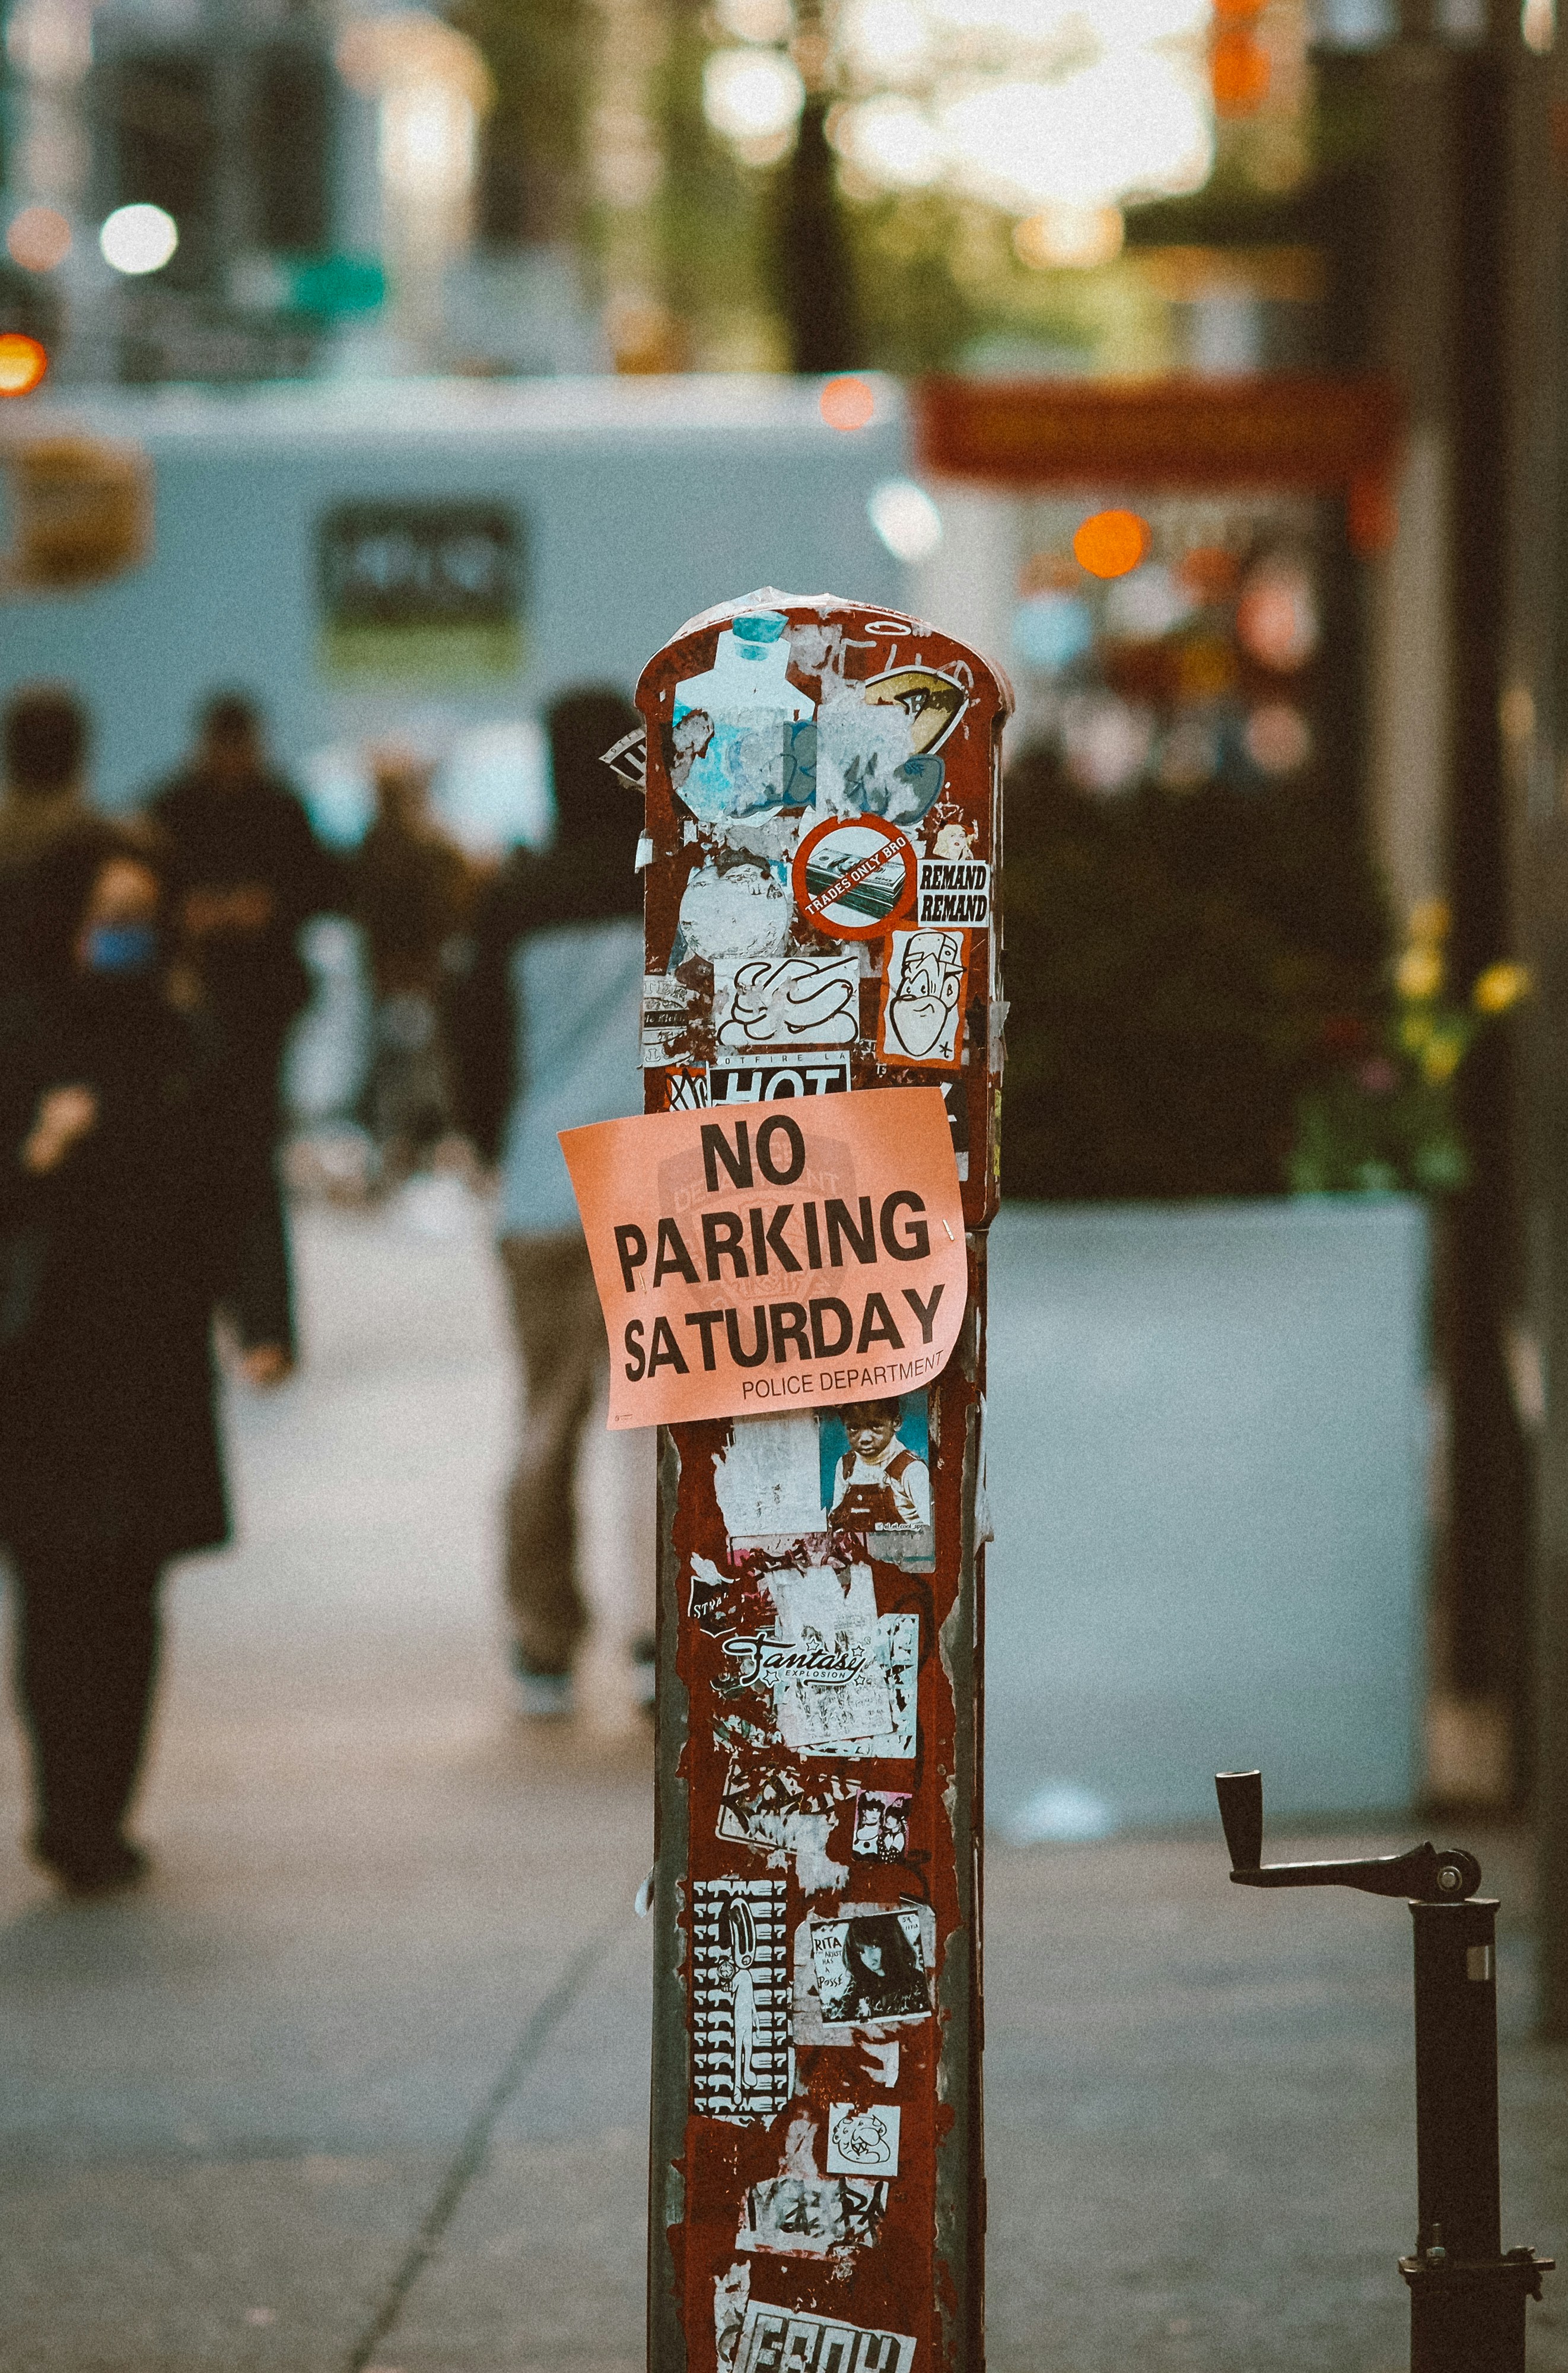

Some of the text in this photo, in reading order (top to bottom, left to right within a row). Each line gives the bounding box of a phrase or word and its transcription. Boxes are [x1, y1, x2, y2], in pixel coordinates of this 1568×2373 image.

[805, 836, 906, 915] TRADES ONLY BRO
[920, 865, 987, 890] REMAND
[921, 895, 987, 921] REMAND
[726, 1068, 840, 1102] HOT
[701, 1114, 806, 1192] NO
[613, 1190, 931, 1293] PARKING
[624, 1284, 946, 1382] SATURDAY
[743, 1350, 944, 1400] POLICE DEPARTMENT
[723, 1632, 867, 1686] Fantasy
[785, 1669, 846, 1678] EXPLOSION
[814, 1936, 842, 1952] RITA
[818, 1974, 843, 1989] POSSE
